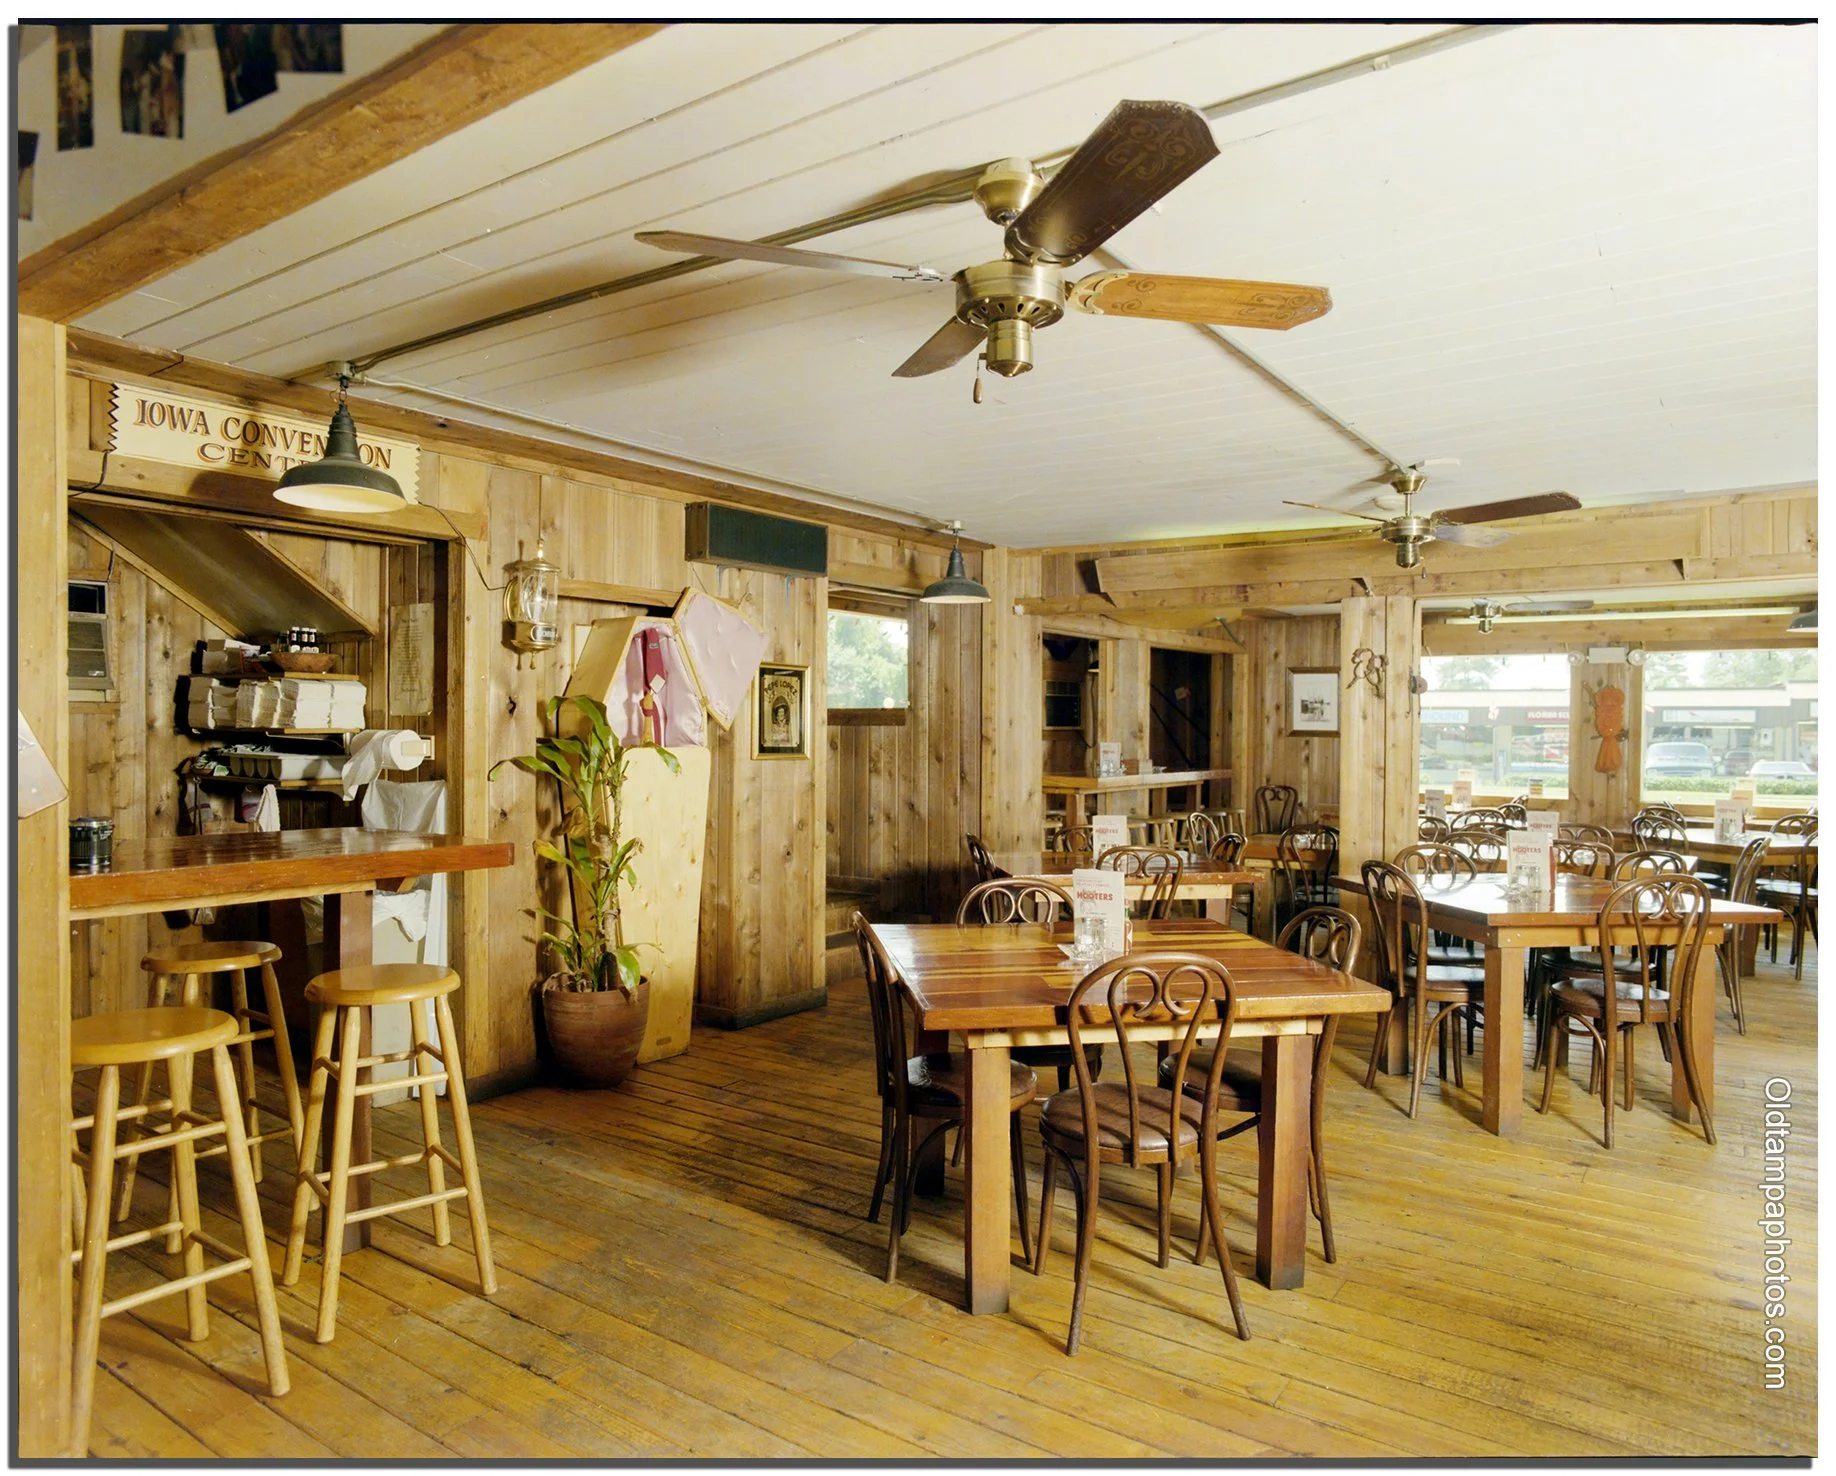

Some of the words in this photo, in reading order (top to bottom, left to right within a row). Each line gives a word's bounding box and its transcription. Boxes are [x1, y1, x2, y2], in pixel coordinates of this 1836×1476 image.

[134, 399, 210, 436] IOWA
[220, 417, 392, 470] CONVENON
[196, 443, 313, 473] CENT
[764, 680, 779, 694] PEPE
[780, 680, 798, 696] LOPEZ
[1077, 891, 1114, 901] HOOTERS
